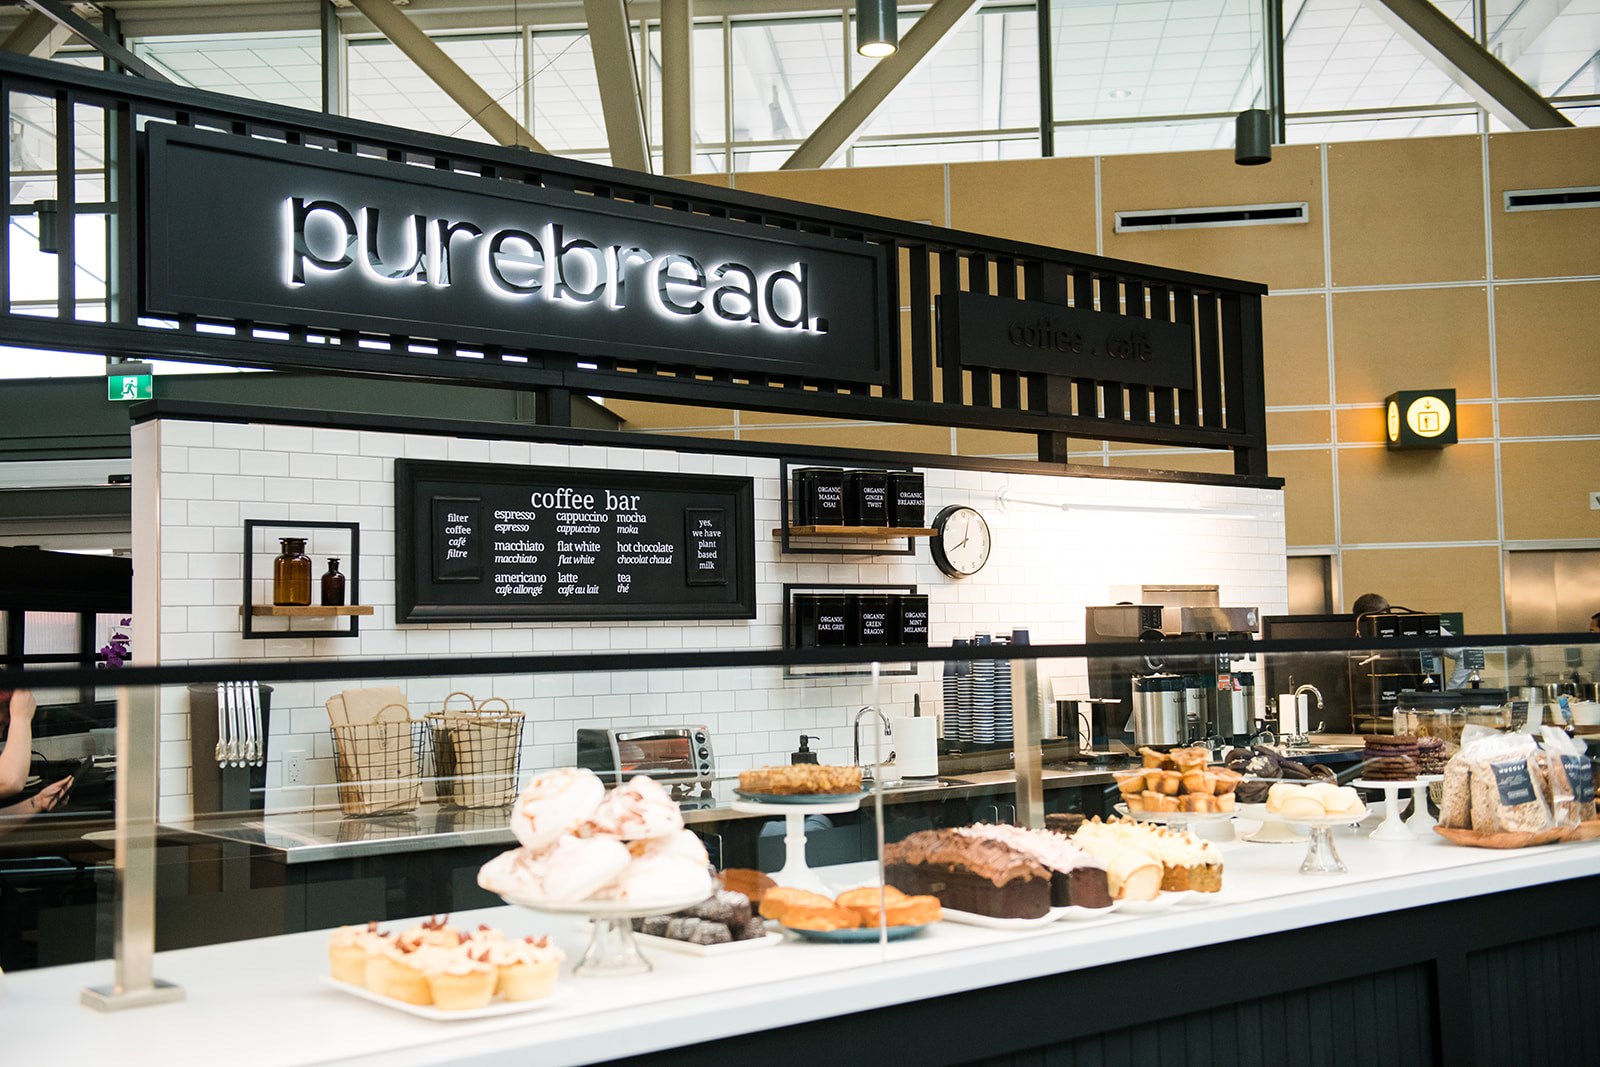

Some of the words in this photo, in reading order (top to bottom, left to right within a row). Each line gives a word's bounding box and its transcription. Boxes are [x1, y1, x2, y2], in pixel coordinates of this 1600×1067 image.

[286, 195, 829, 335] purebread.
[1007, 315, 1083, 354] coffee
[531, 487, 595, 510] coffee
[604, 489, 641, 511] bar
[447, 513, 469, 523] filter
[494, 510, 536, 522] espresso
[556, 511, 608, 524] cappuccino
[616, 512, 647, 523] mocha
[445, 525, 471, 534] coffee
[494, 523, 530, 534] espresso
[556, 524, 600, 535] cappuccino
[616, 525, 639, 534] moka
[704, 528, 722, 538] have
[448, 537, 466, 548] café
[494, 540, 545, 552] macchiato
[557, 541, 574, 552] flat
[575, 541, 601, 552] white
[616, 541, 632, 553] hot
[633, 542, 674, 553] chocolate
[698, 539, 716, 549] plant
[446, 549, 468, 560] filtre
[494, 554, 538, 564] macchiato
[617, 554, 648, 564] chocolat
[649, 555, 673, 565] chaud
[697, 550, 718, 559] based
[557, 554, 573, 567] flat
[573, 555, 595, 564] white
[699, 561, 715, 570] milk
[494, 572, 547, 583] americano
[557, 572, 578, 583] latte
[617, 573, 631, 583] tea
[513, 584, 543, 597] allongé
[557, 584, 574, 597] café
[586, 585, 599, 595] lait
[617, 583, 630, 593] thé
